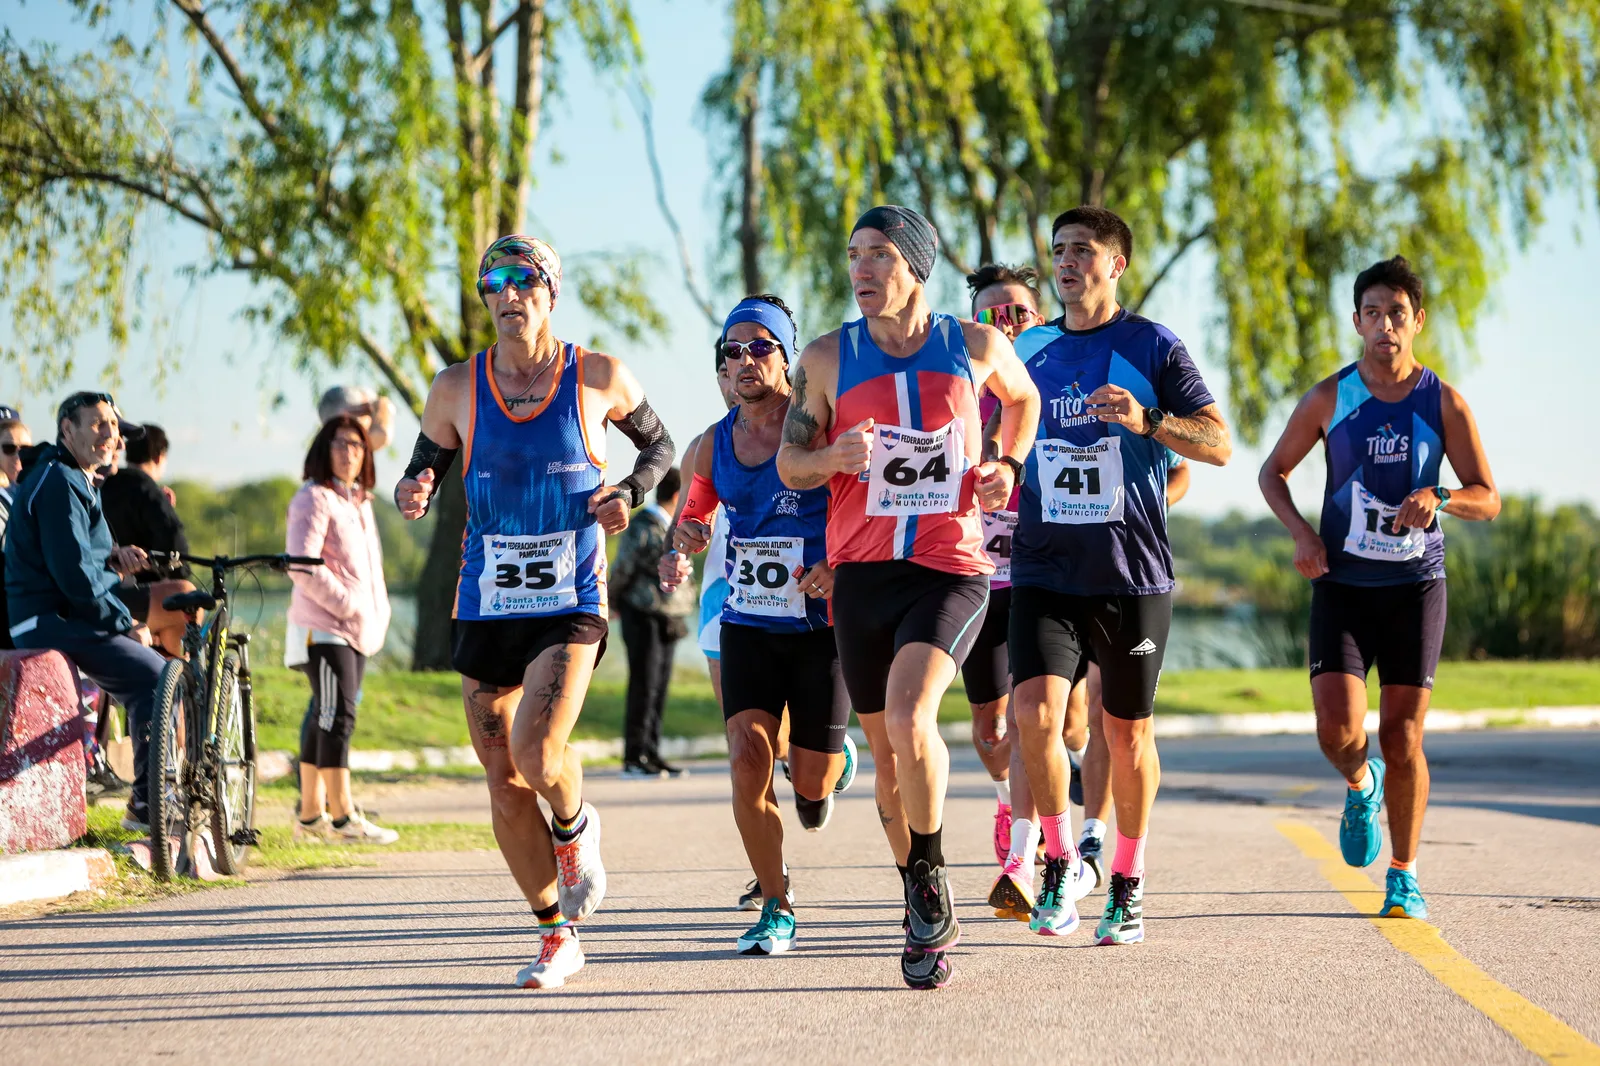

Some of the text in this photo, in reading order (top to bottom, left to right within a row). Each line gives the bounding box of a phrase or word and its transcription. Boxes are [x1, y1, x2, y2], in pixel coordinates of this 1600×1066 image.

[1060, 414, 1097, 428] Runners
[900, 434, 934, 445] FEDERACION
[1058, 444, 1108, 454] FEDERACION ATLETICA
[1374, 452, 1408, 464] Runners
[882, 452, 950, 486] 64
[1054, 467, 1100, 494] 41
[772, 490, 801, 502] ATLETISMO
[508, 538, 562, 551] FEDERACION ATLETICA
[1372, 538, 1394, 548] Santa
[518, 549, 549, 558] PAMPEANA
[495, 560, 556, 590] 35
[737, 560, 790, 588] 30
[536, 594, 558, 602] Rosa
[746, 599, 788, 608] MUNICIPIO
[770, 594, 788, 602] Rosa
[504, 600, 558, 610] MUNICIPIO
